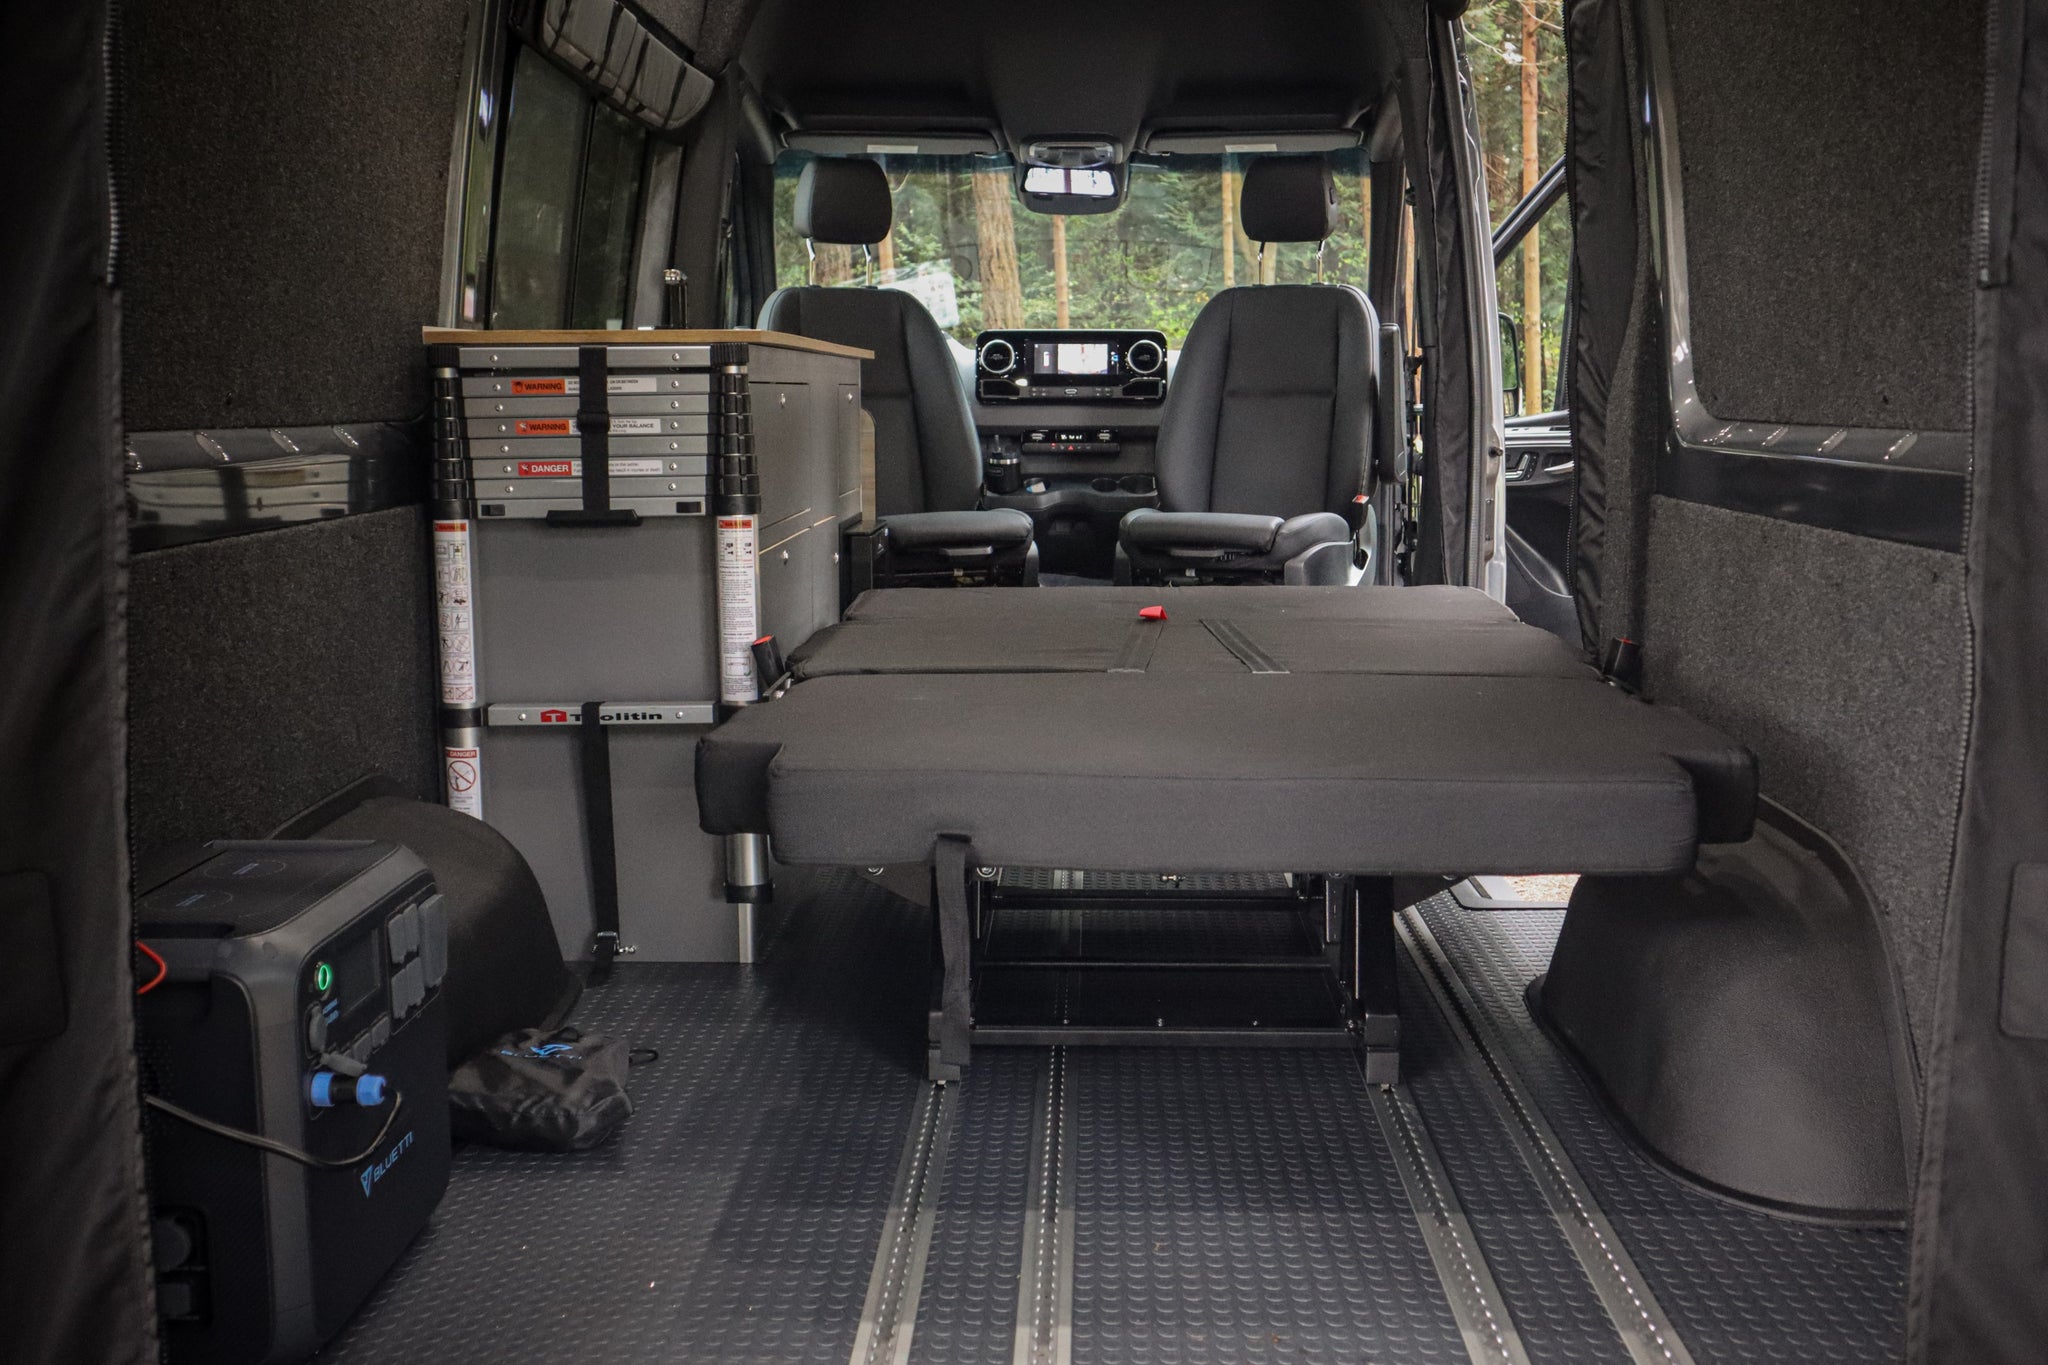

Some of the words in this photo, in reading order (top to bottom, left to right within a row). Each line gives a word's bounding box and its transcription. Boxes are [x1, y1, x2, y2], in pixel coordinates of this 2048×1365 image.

[524, 382, 562, 392] WARNING
[529, 422, 567, 432] WARNING
[531, 464, 569, 474] DANGER
[569, 712, 663, 722] Tolitin
[374, 1132, 414, 1182] BLUETTI
